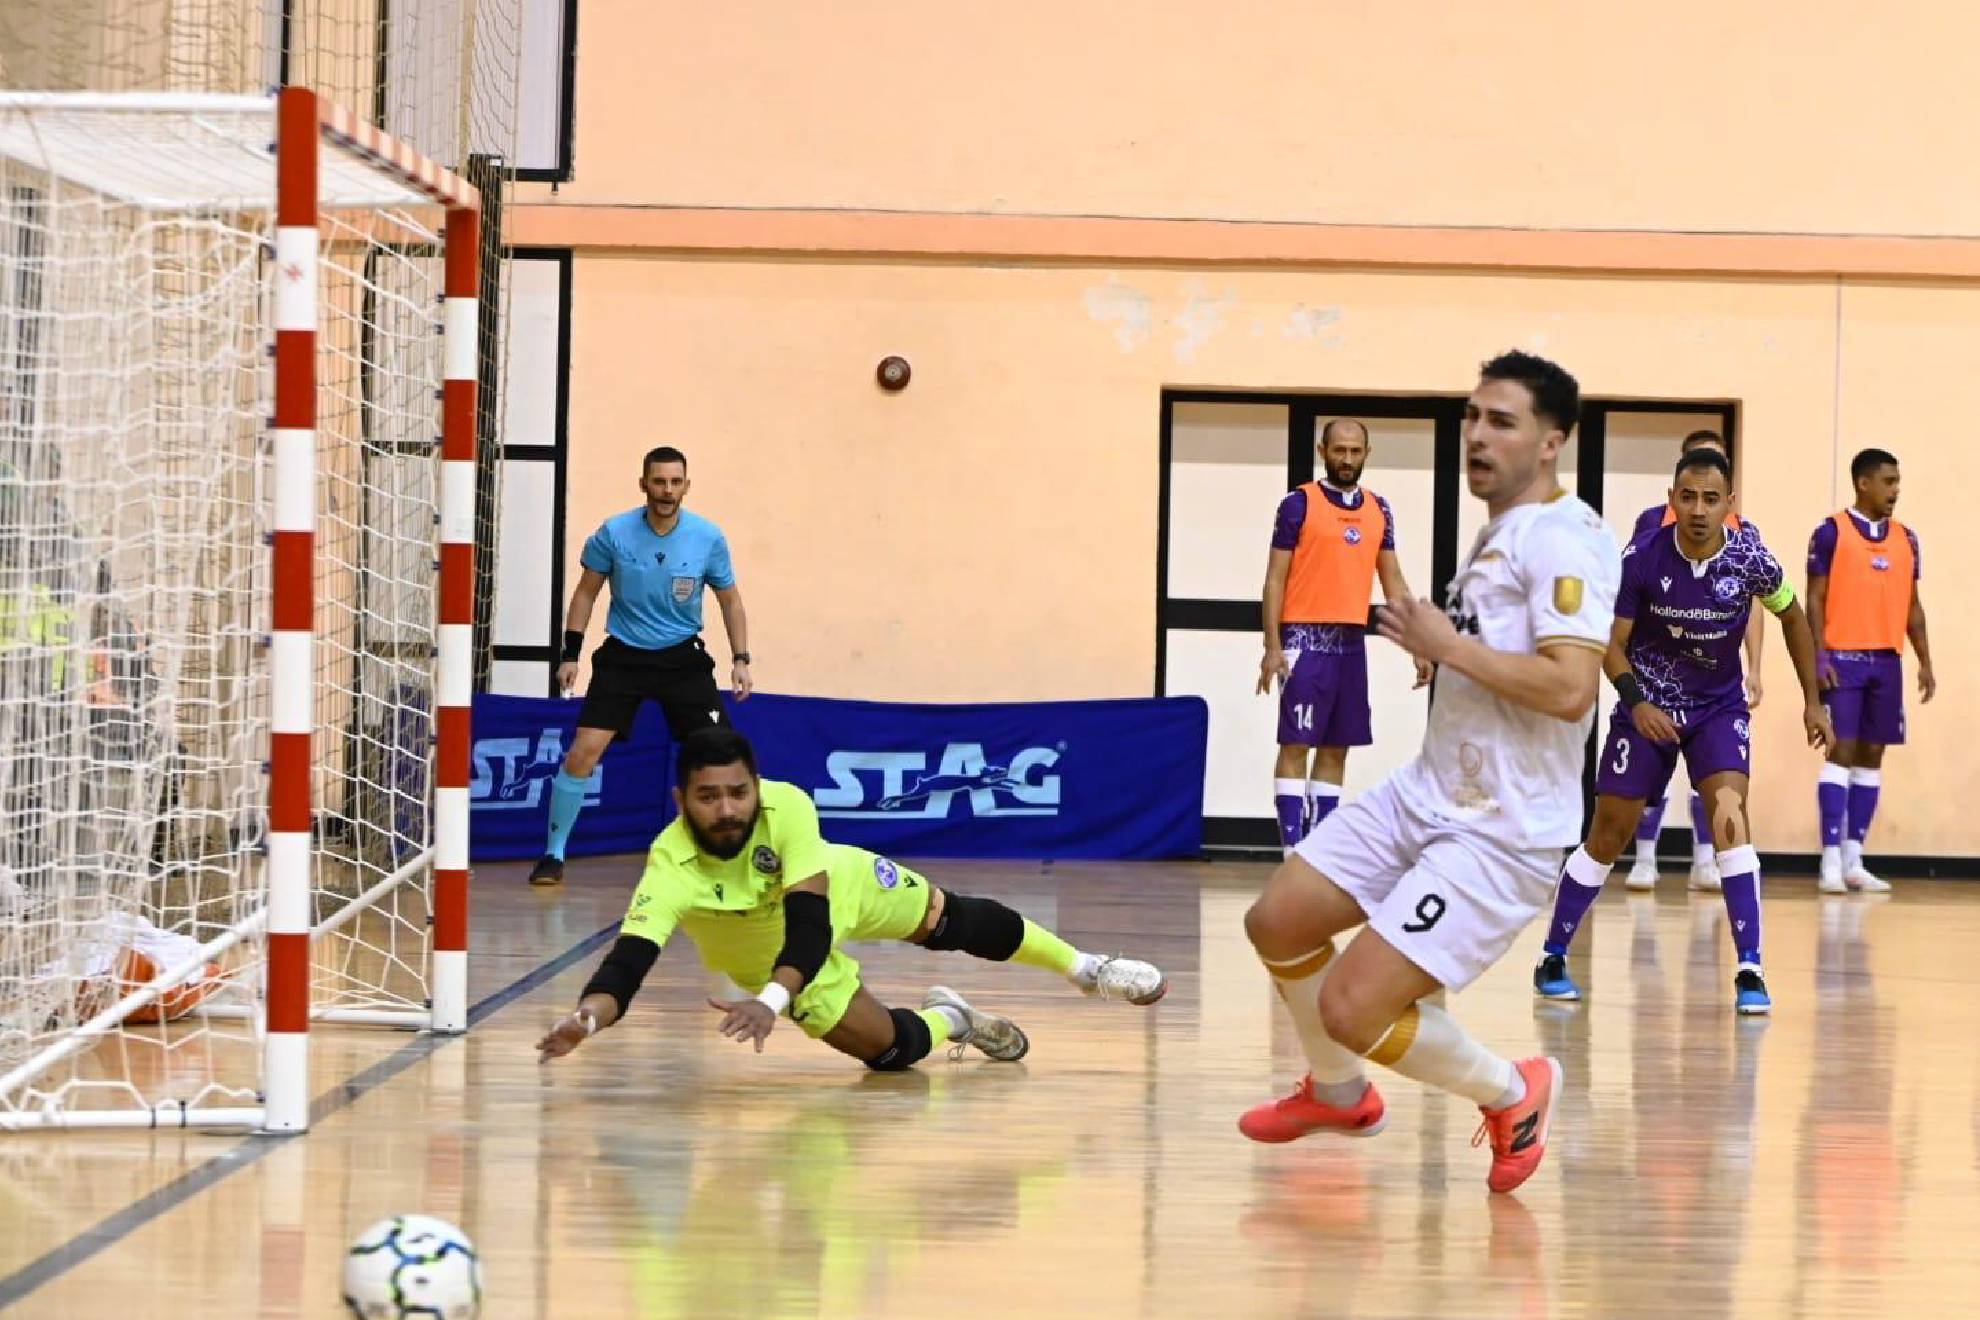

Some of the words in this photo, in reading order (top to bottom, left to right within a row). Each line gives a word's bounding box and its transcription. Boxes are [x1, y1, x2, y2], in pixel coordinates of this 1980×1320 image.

[1649, 602, 1737, 621] Holland&Ba
[1294, 703, 1314, 731] 14
[1612, 737, 1631, 775] 3
[813, 743, 1061, 819] STAG
[1401, 893, 1446, 933] 9
